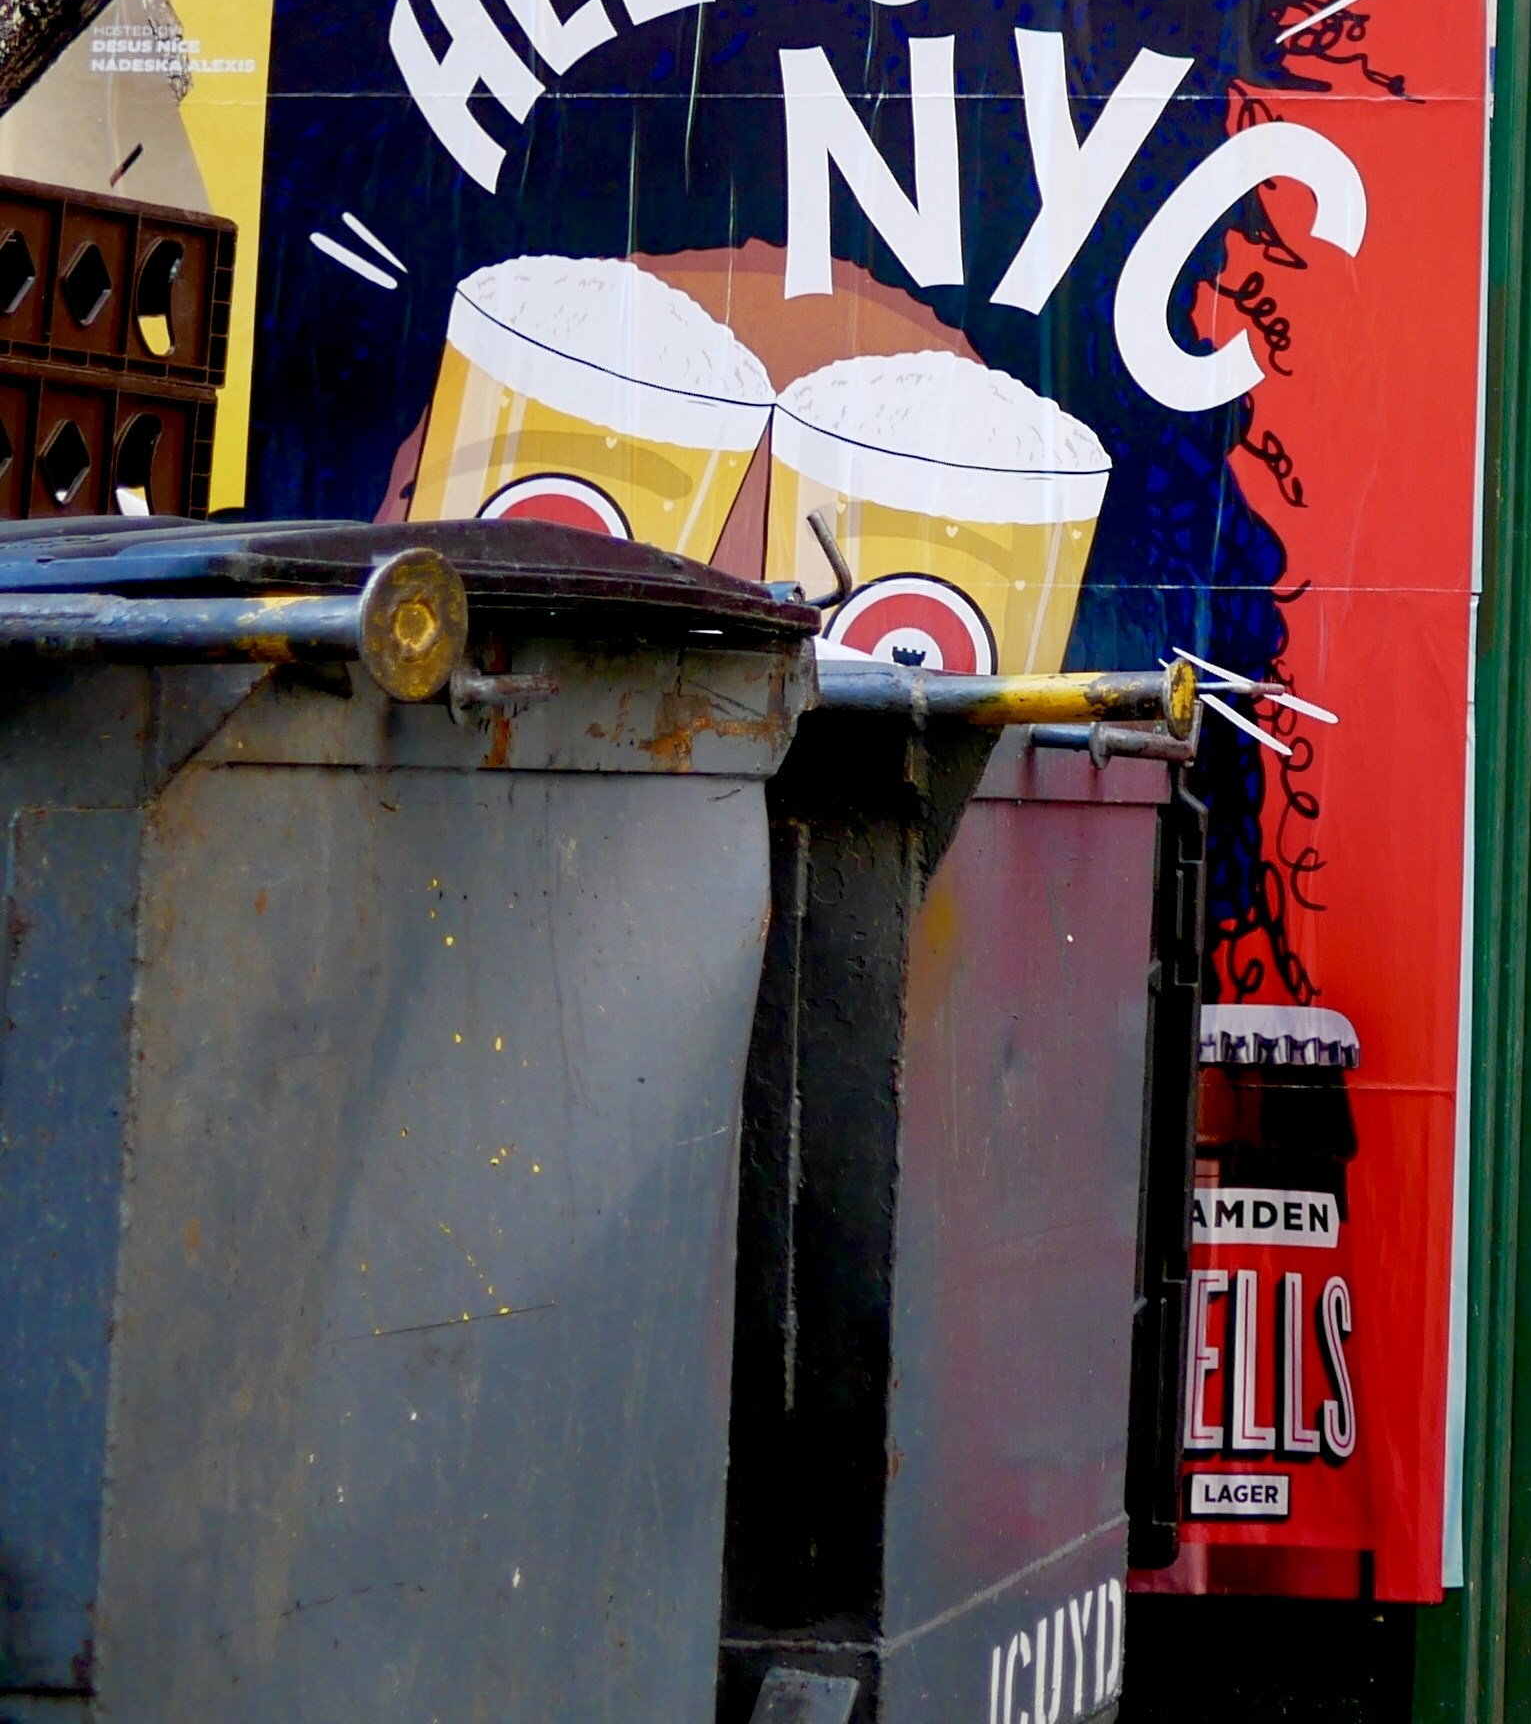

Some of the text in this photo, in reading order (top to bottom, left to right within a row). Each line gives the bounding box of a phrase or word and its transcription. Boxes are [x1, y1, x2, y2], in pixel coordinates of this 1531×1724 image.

[94, 27, 153, 37] HOSTED
[92, 40, 201, 53] DESUS NICE
[91, 59, 256, 72] NADESKA ALEXIS
[779, 26, 1367, 412] NYC
[1184, 1269, 1355, 1458] ELLS
[1204, 1484, 1278, 1505] LAGER
